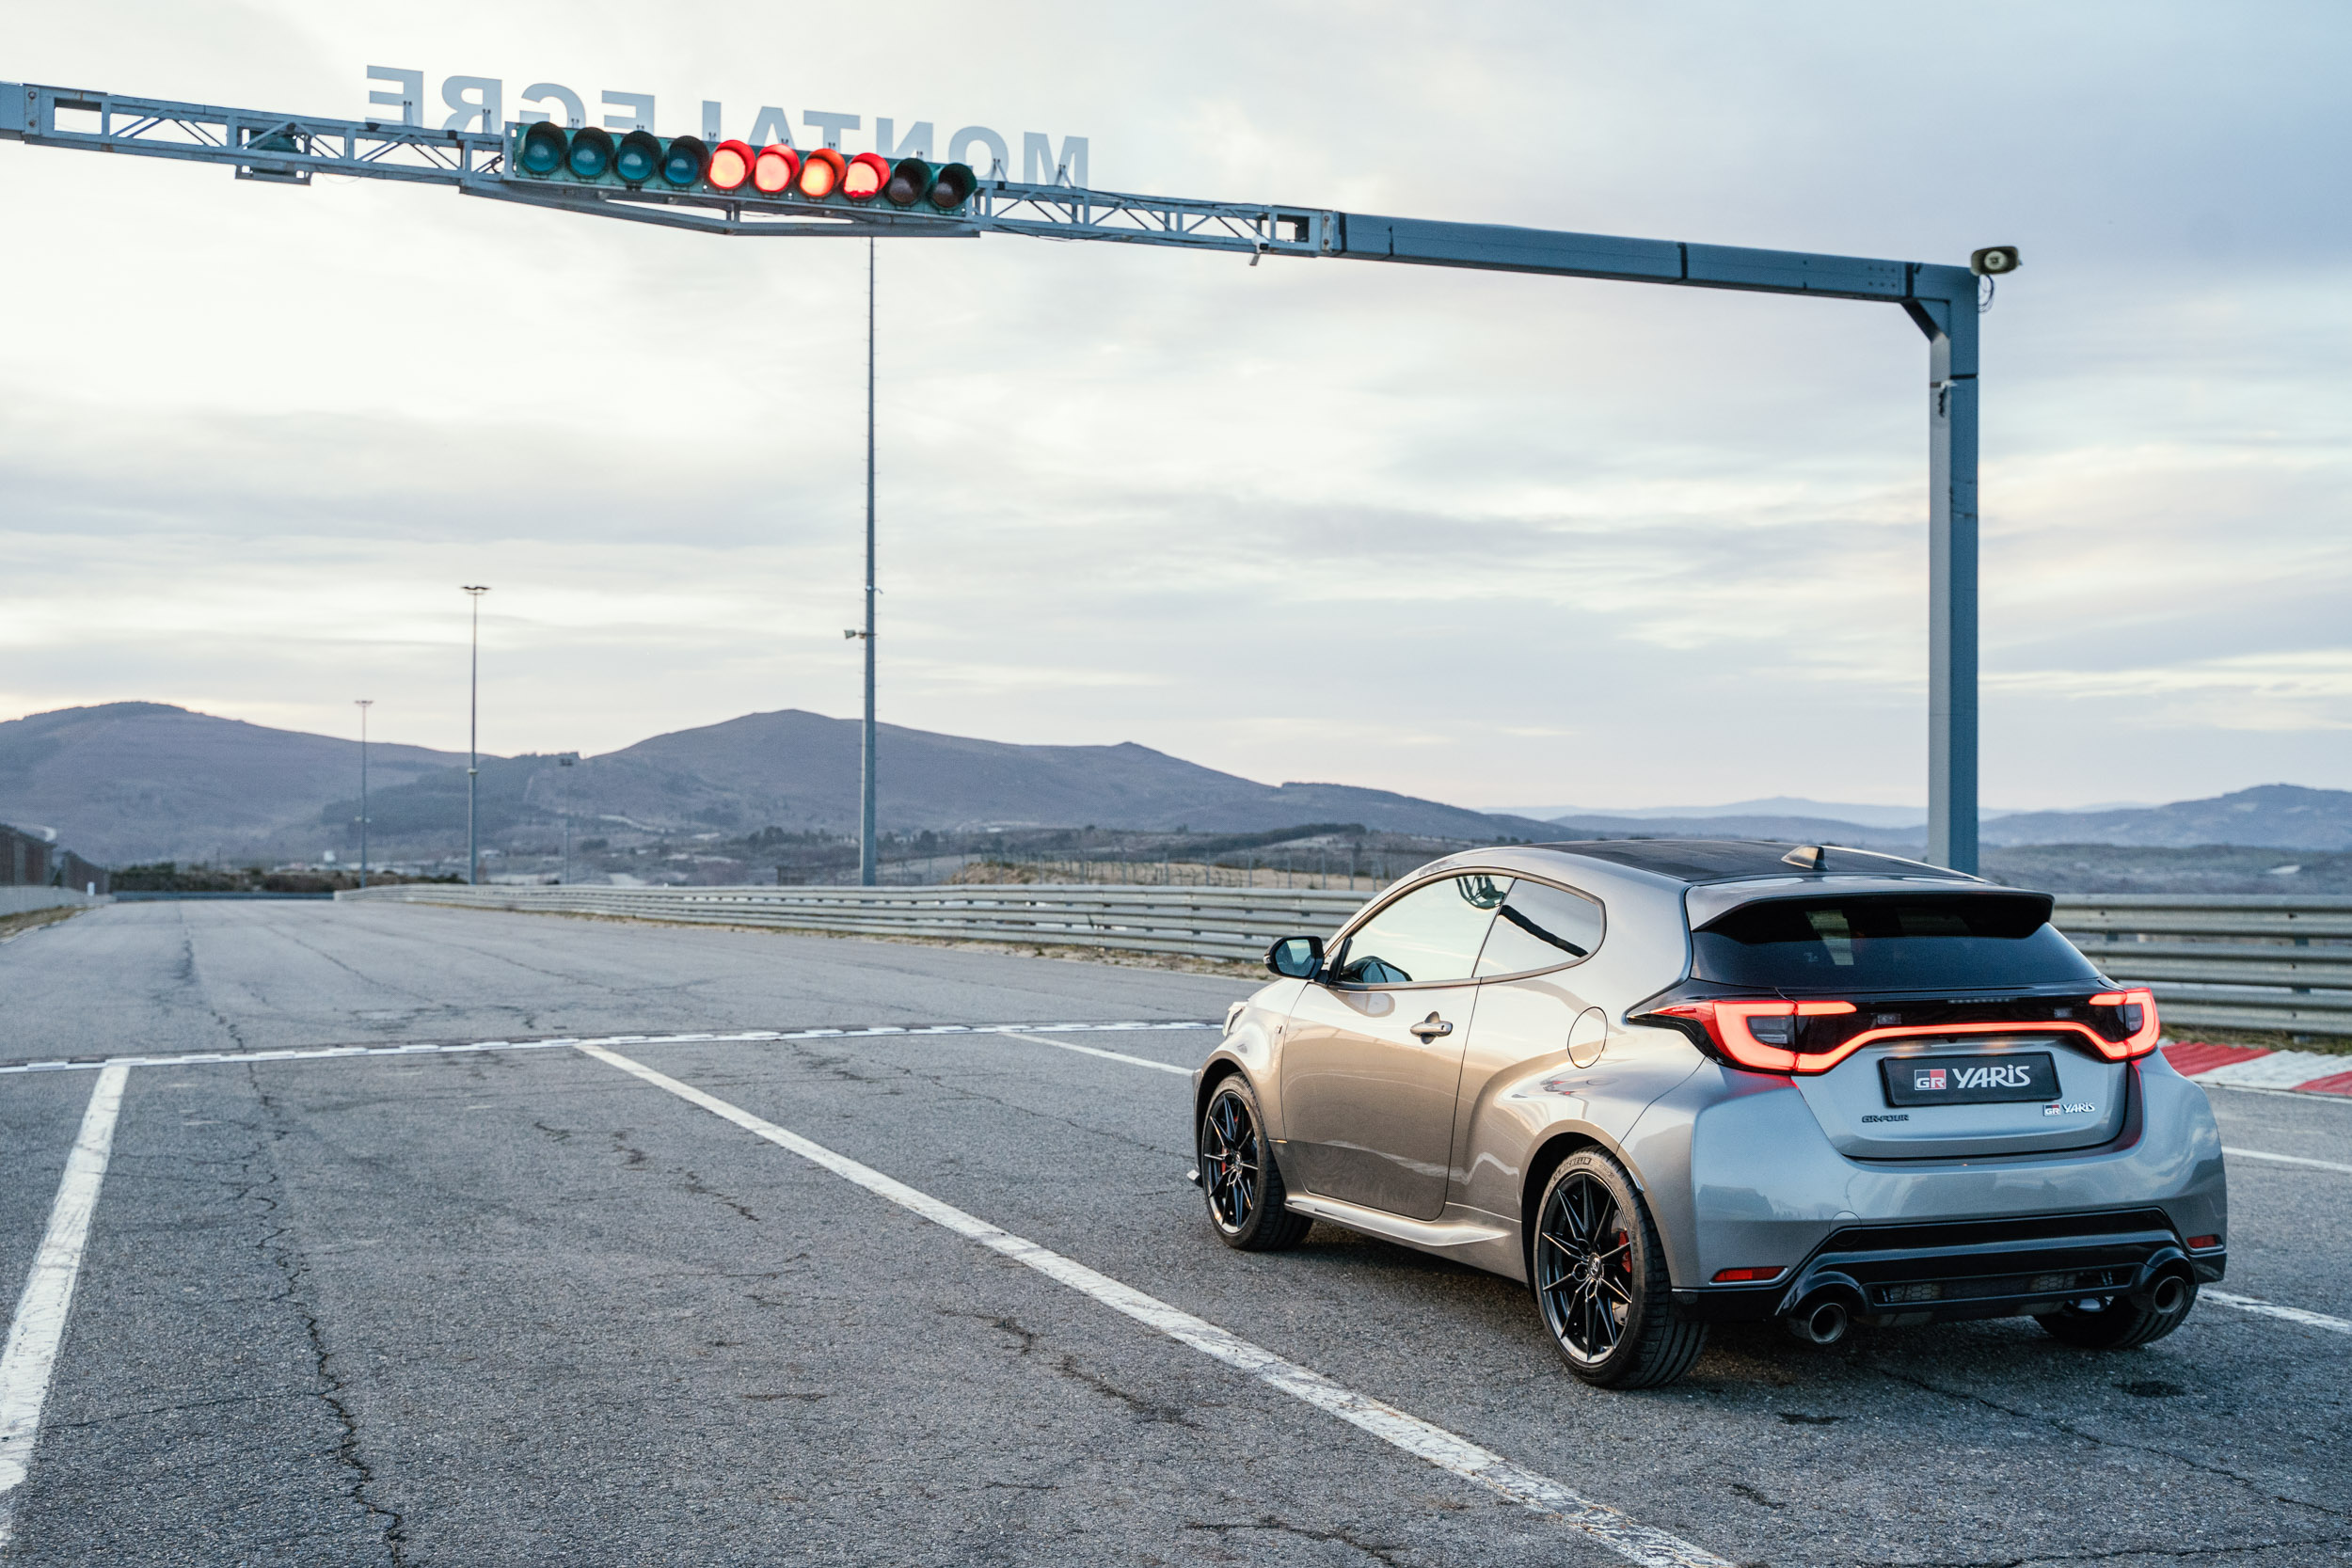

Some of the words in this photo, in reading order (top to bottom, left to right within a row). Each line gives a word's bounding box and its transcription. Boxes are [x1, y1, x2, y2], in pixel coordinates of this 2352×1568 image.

[1915, 1075, 1947, 1089] GR
[2044, 1106, 2060, 1116] GR
[1862, 1114, 1909, 1123] GR-FOUR
